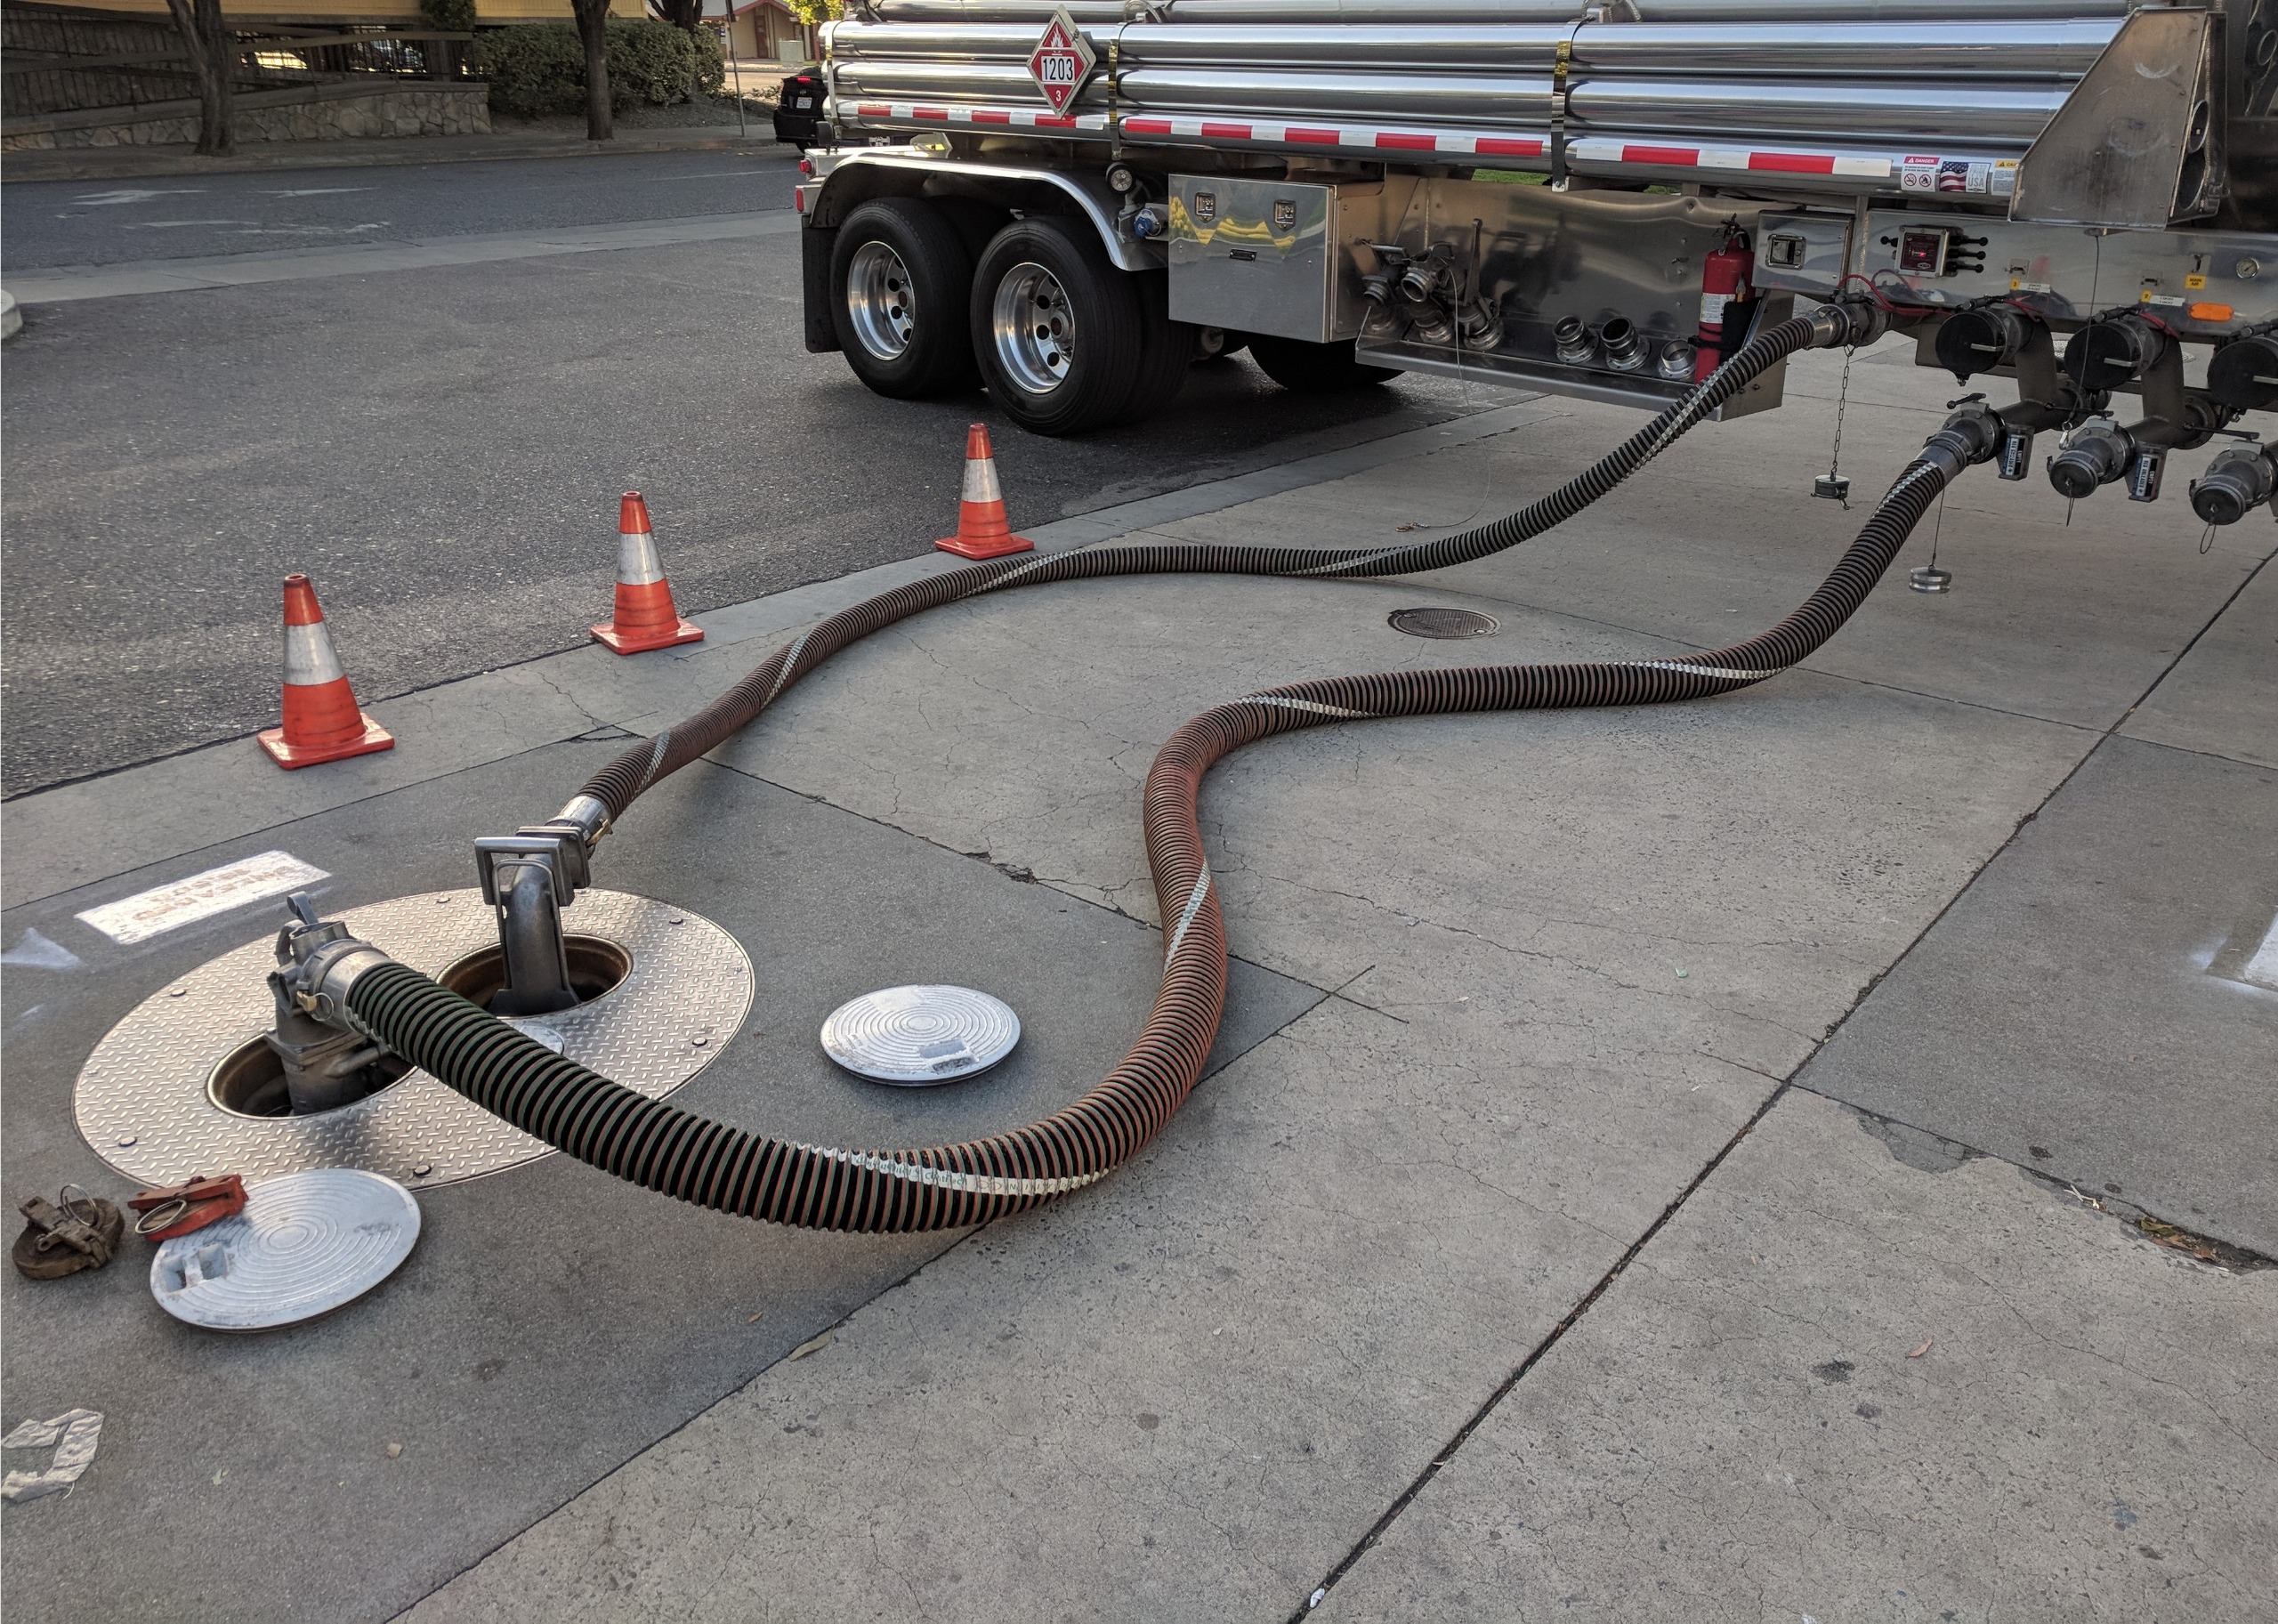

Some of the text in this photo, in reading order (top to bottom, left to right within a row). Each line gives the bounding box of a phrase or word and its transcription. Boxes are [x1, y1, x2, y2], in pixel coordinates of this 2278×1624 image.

[1042, 57, 1073, 81] 1203
[1055, 89, 1062, 101] 3
[1967, 176, 1984, 188] USA
